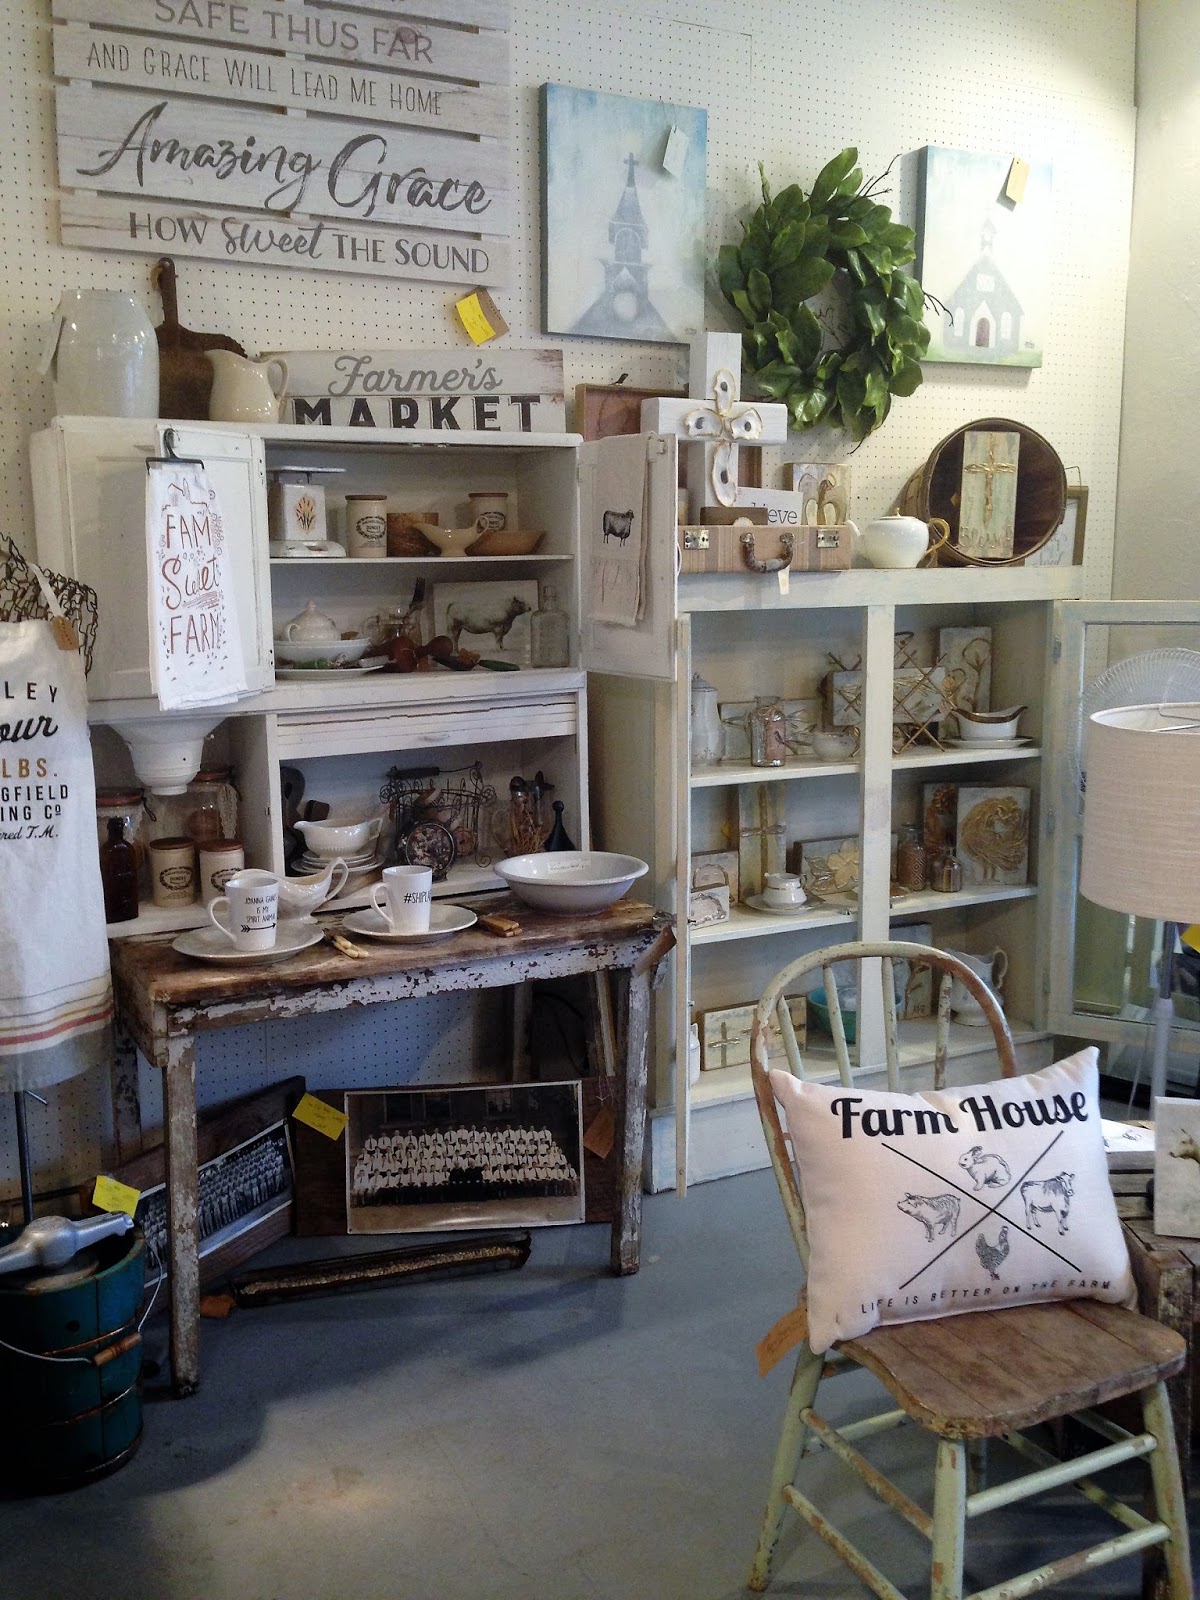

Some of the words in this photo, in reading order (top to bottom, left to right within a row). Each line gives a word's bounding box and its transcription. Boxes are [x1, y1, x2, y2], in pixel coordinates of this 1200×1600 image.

[154, 0, 250, 34] SAFE
[262, 10, 360, 51] THUS
[372, 27, 434, 64] FAR
[87, 42, 131, 72] AND
[143, 46, 211, 83] GRACE
[224, 57, 278, 92] WILL
[290, 67, 339, 101] LEAD
[350, 76, 378, 107] ME
[389, 82, 443, 116] HOME
[76, 101, 322, 211] Amazing
[327, 133, 492, 217] Grace
[129, 211, 208, 245] HOW
[331, 232, 386, 263] THE
[394, 238, 490, 274] SOUND
[327, 354, 503, 398] Farmer's
[291, 395, 541, 433] MARKET
[169, 612, 221, 655] FARM
[2, 757, 58, 779] LBS.
[26, 824, 59, 838] T.M.
[831, 1097, 959, 1139] Farm
[959, 1091, 1088, 1132] House
[861, 1298, 893, 1314] LIFE
[905, 1296, 918, 1305] IS
[931, 1287, 991, 1302] BETTER
[1002, 1286, 1020, 1295] ON
[1031, 1280, 1057, 1291] THE
[1067, 1279, 1110, 1290] FARM
